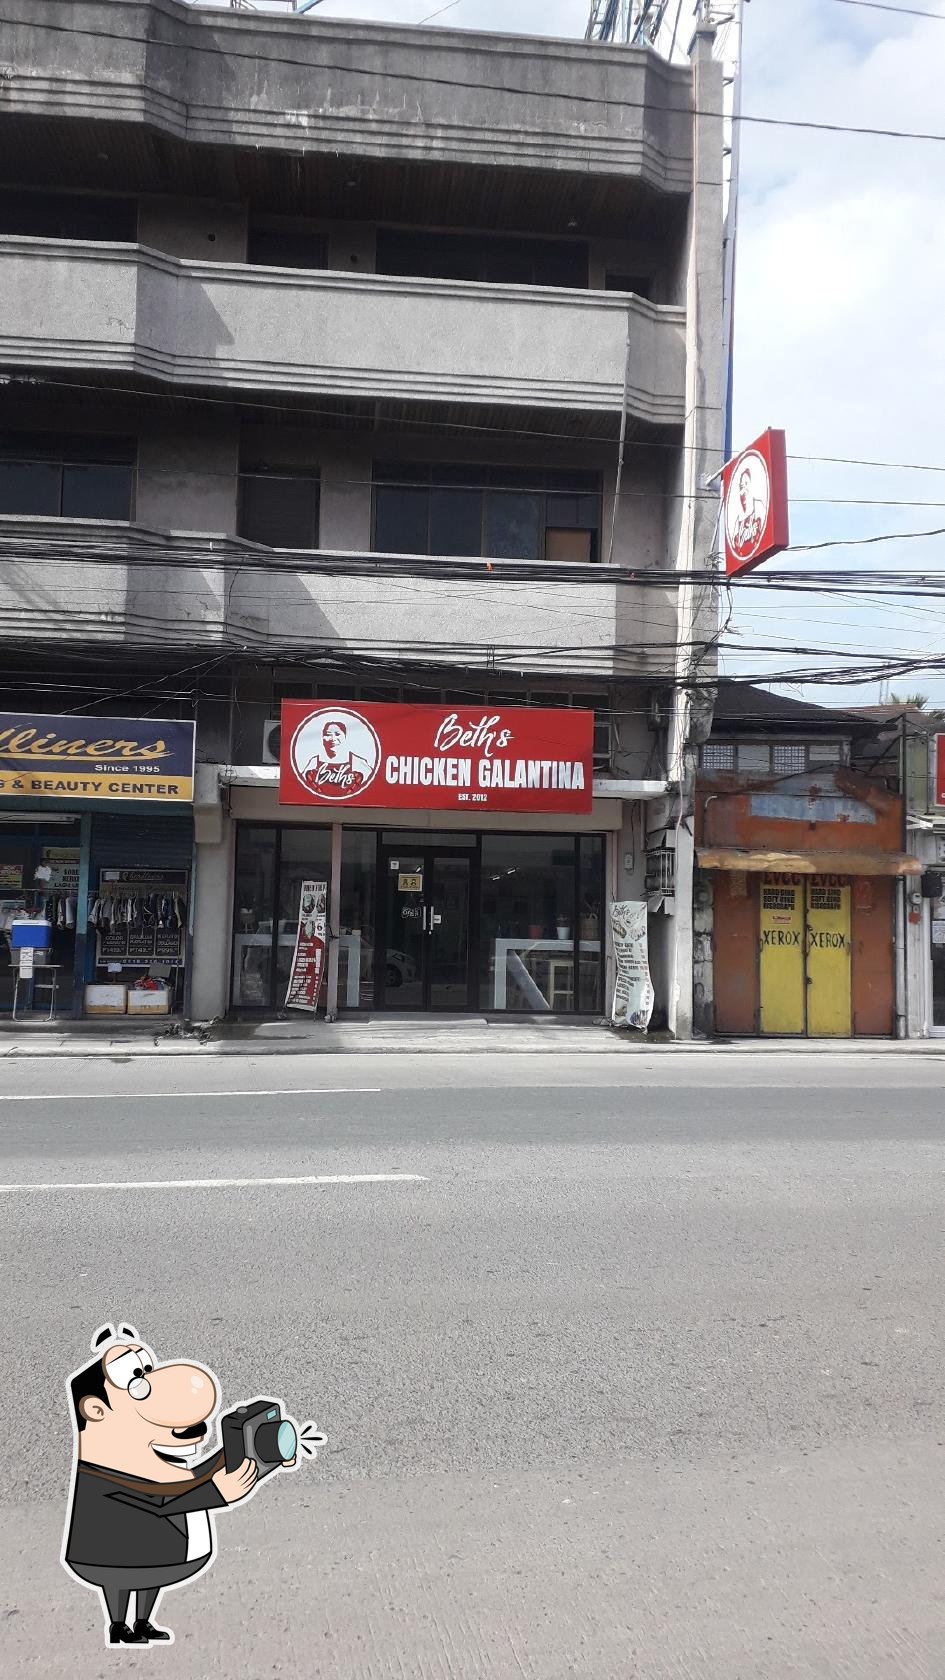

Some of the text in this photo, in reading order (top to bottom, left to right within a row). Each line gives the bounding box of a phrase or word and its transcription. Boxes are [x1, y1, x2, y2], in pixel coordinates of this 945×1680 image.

[95, 764, 160, 773] Since 1995
[385, 755, 585, 790] CHICKEN GALANTINA
[12, 779, 24, 789] &
[31, 780, 101, 792] BEAUTY
[108, 782, 179, 795] CENTER
[458, 793, 488, 802] EST. 2012
[763, 930, 800, 946] XEROX
[810, 932, 846, 949] XEROX
